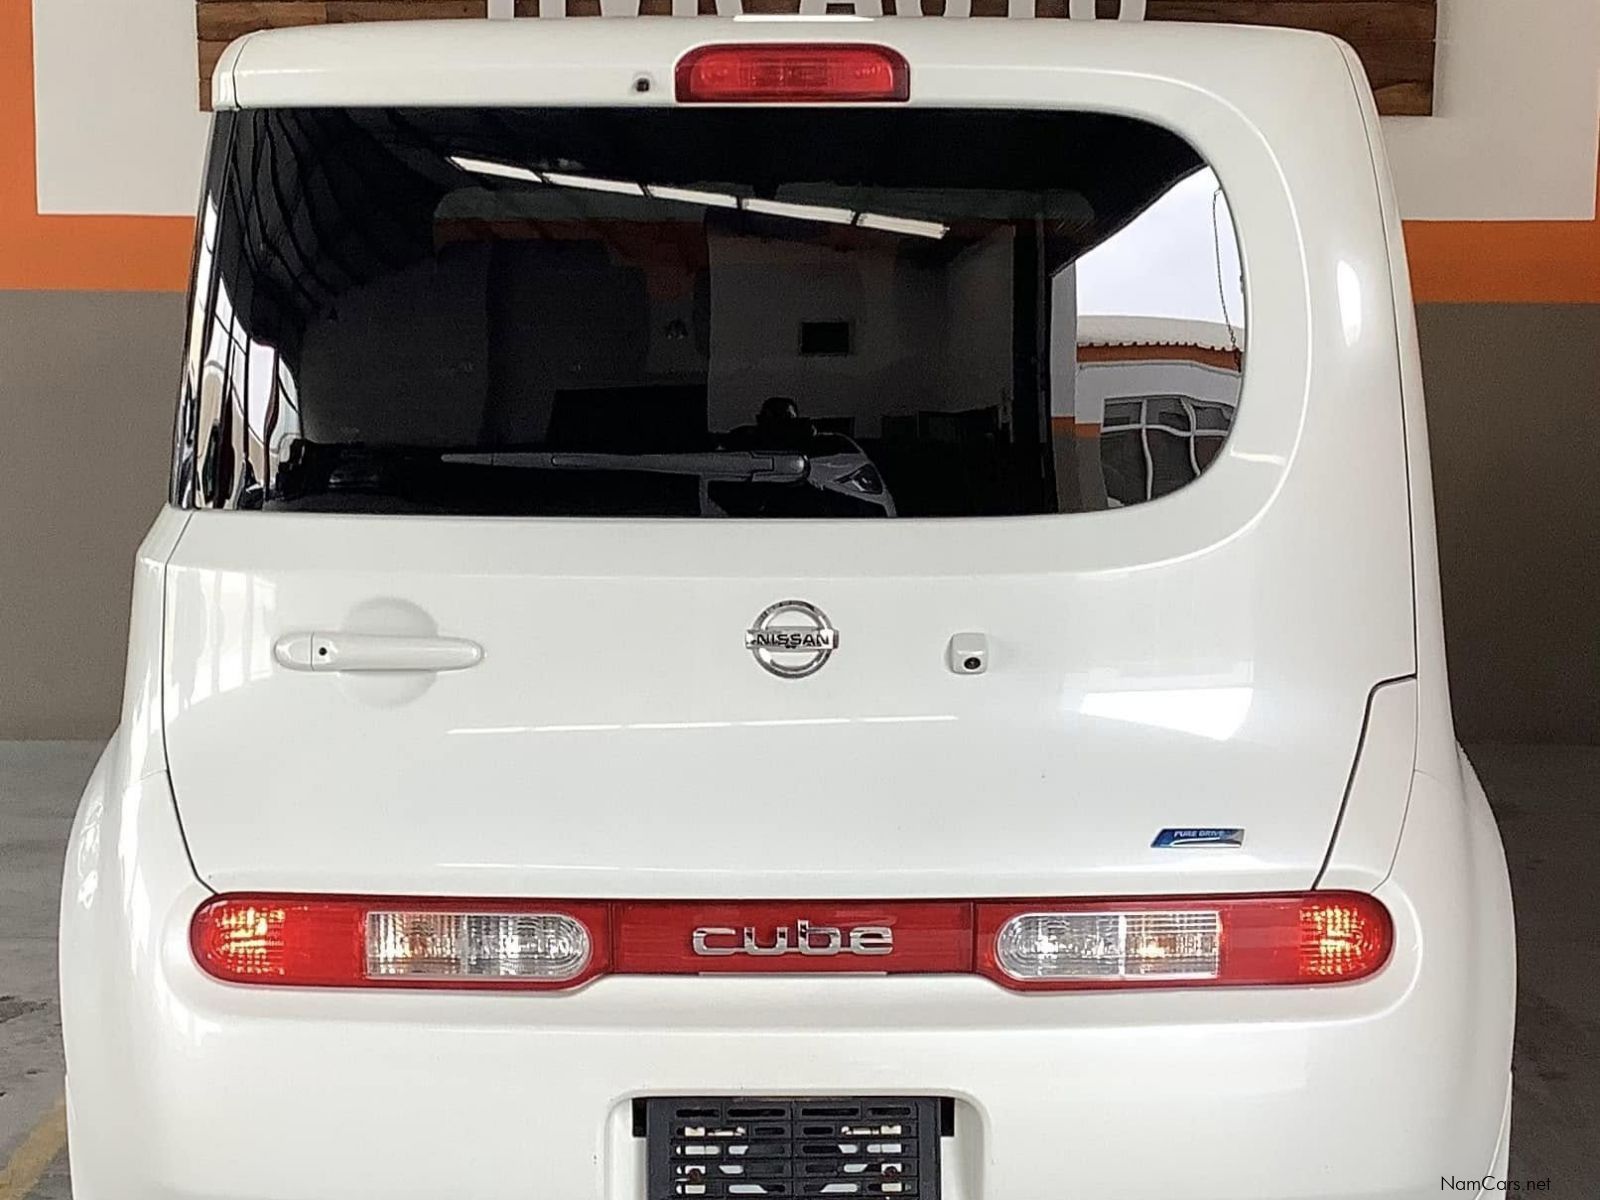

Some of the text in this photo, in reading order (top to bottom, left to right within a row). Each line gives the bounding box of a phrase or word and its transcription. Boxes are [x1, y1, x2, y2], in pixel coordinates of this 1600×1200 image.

[756, 633, 830, 647] NISSAN
[1173, 830, 1225, 838] PURE DRIVE
[692, 919, 894, 956] cube
